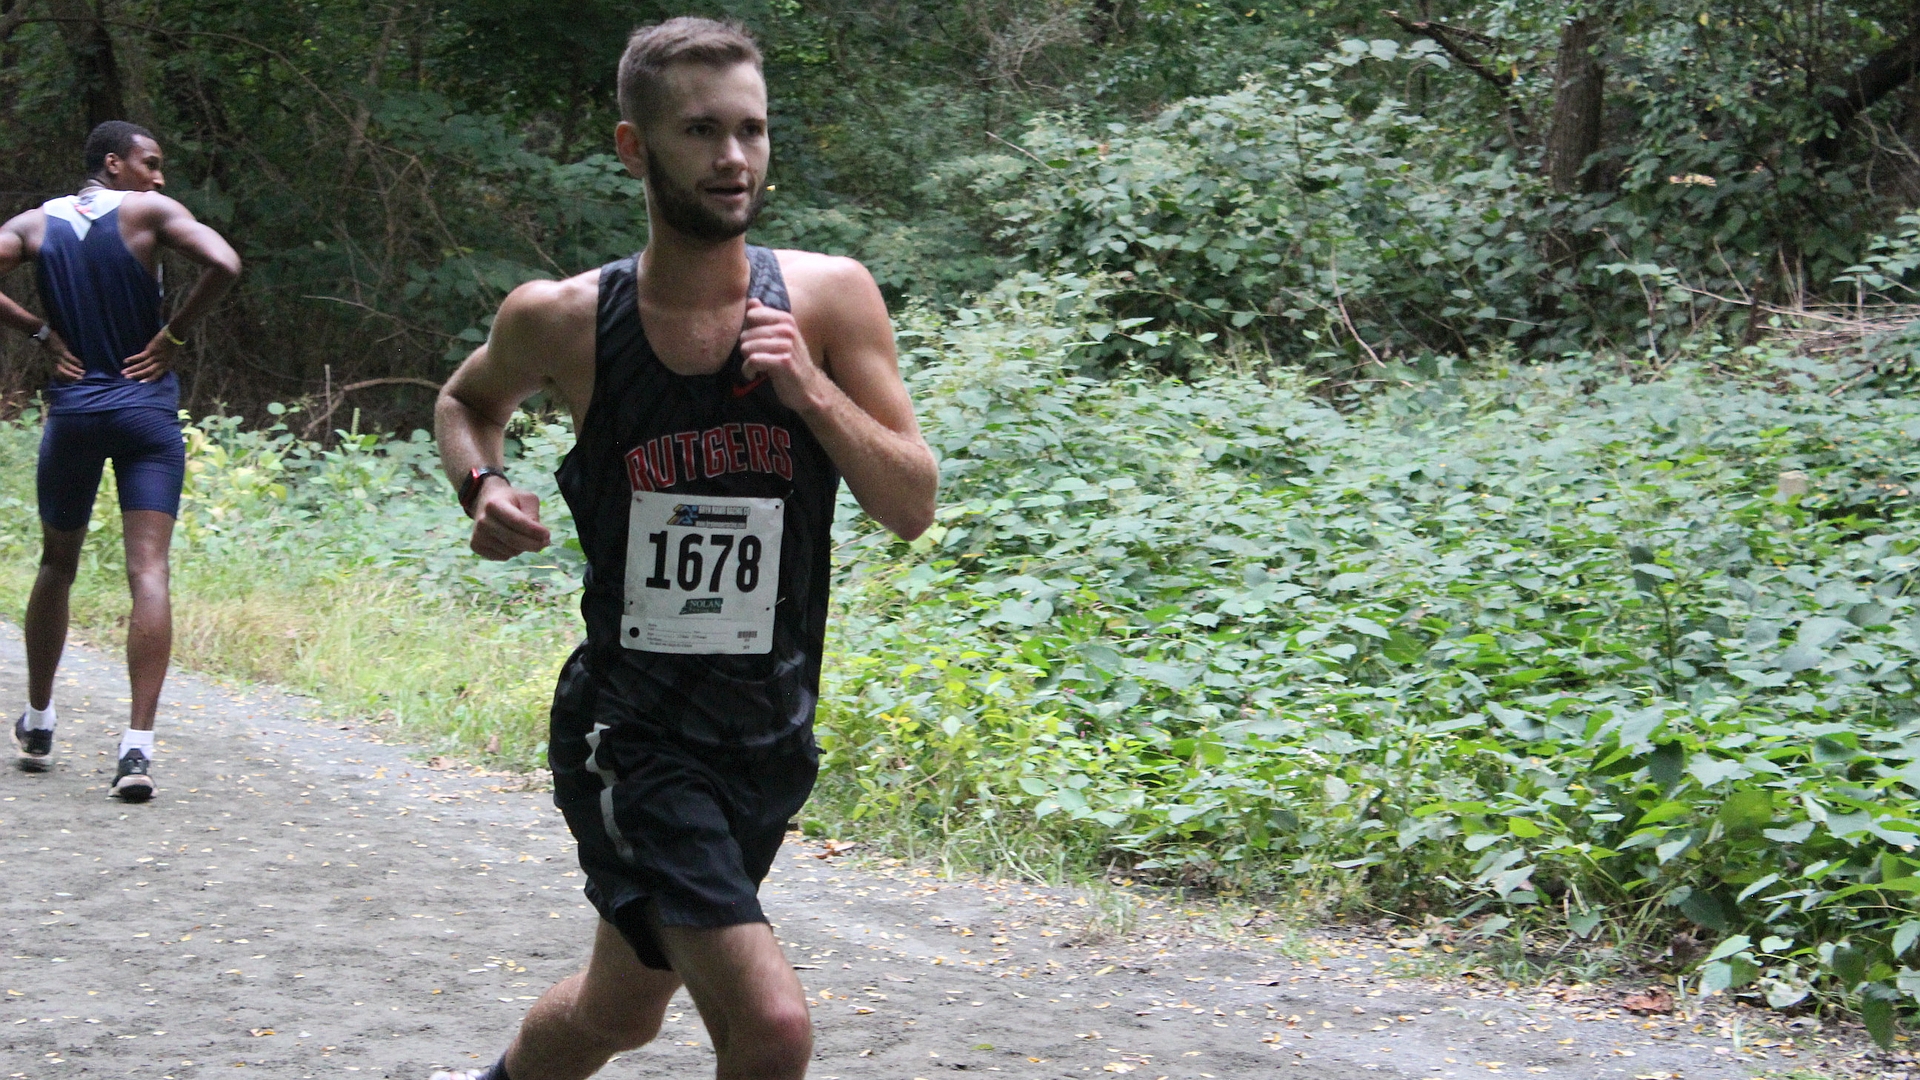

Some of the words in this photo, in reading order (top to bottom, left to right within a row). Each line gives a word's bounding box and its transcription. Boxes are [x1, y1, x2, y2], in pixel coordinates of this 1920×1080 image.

[624, 423, 793, 492] RUTGERS
[646, 530, 762, 593] 1678
[690, 599, 722, 608] NOLAN
